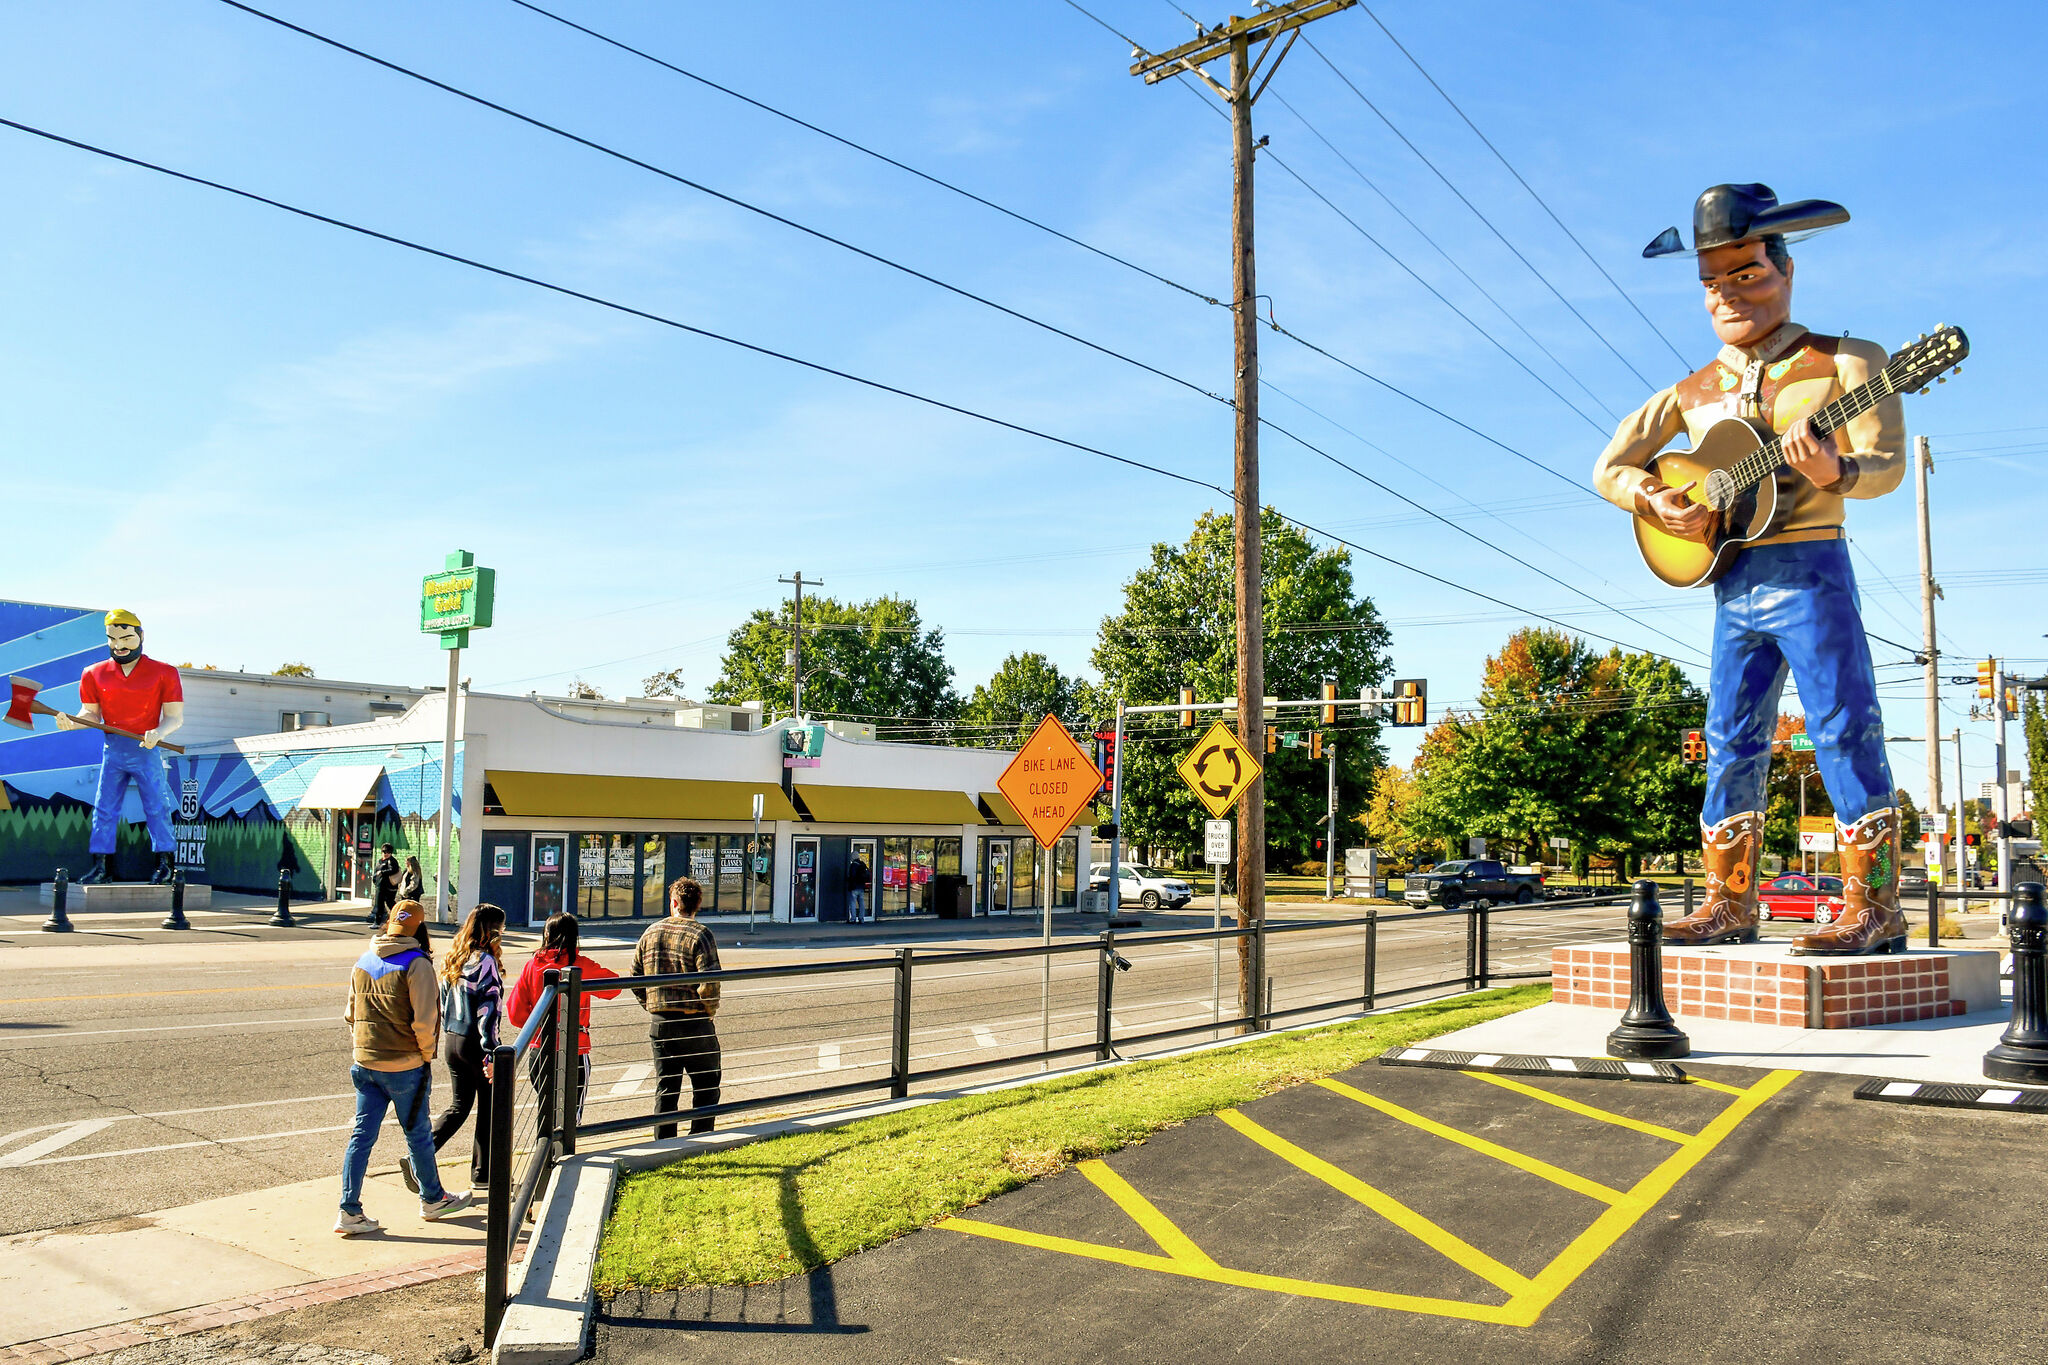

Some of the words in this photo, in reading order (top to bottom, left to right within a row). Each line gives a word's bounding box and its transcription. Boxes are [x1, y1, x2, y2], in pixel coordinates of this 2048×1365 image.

[1023, 759, 1045, 772] BIKE
[1050, 757, 1076, 771] LANE
[1106, 743, 1115, 791] CAFE
[1029, 781, 1068, 795] CLOSED
[182, 795, 197, 815] 66
[1032, 805, 1065, 819] AHEAD
[721, 859, 743, 867] CLASSES
